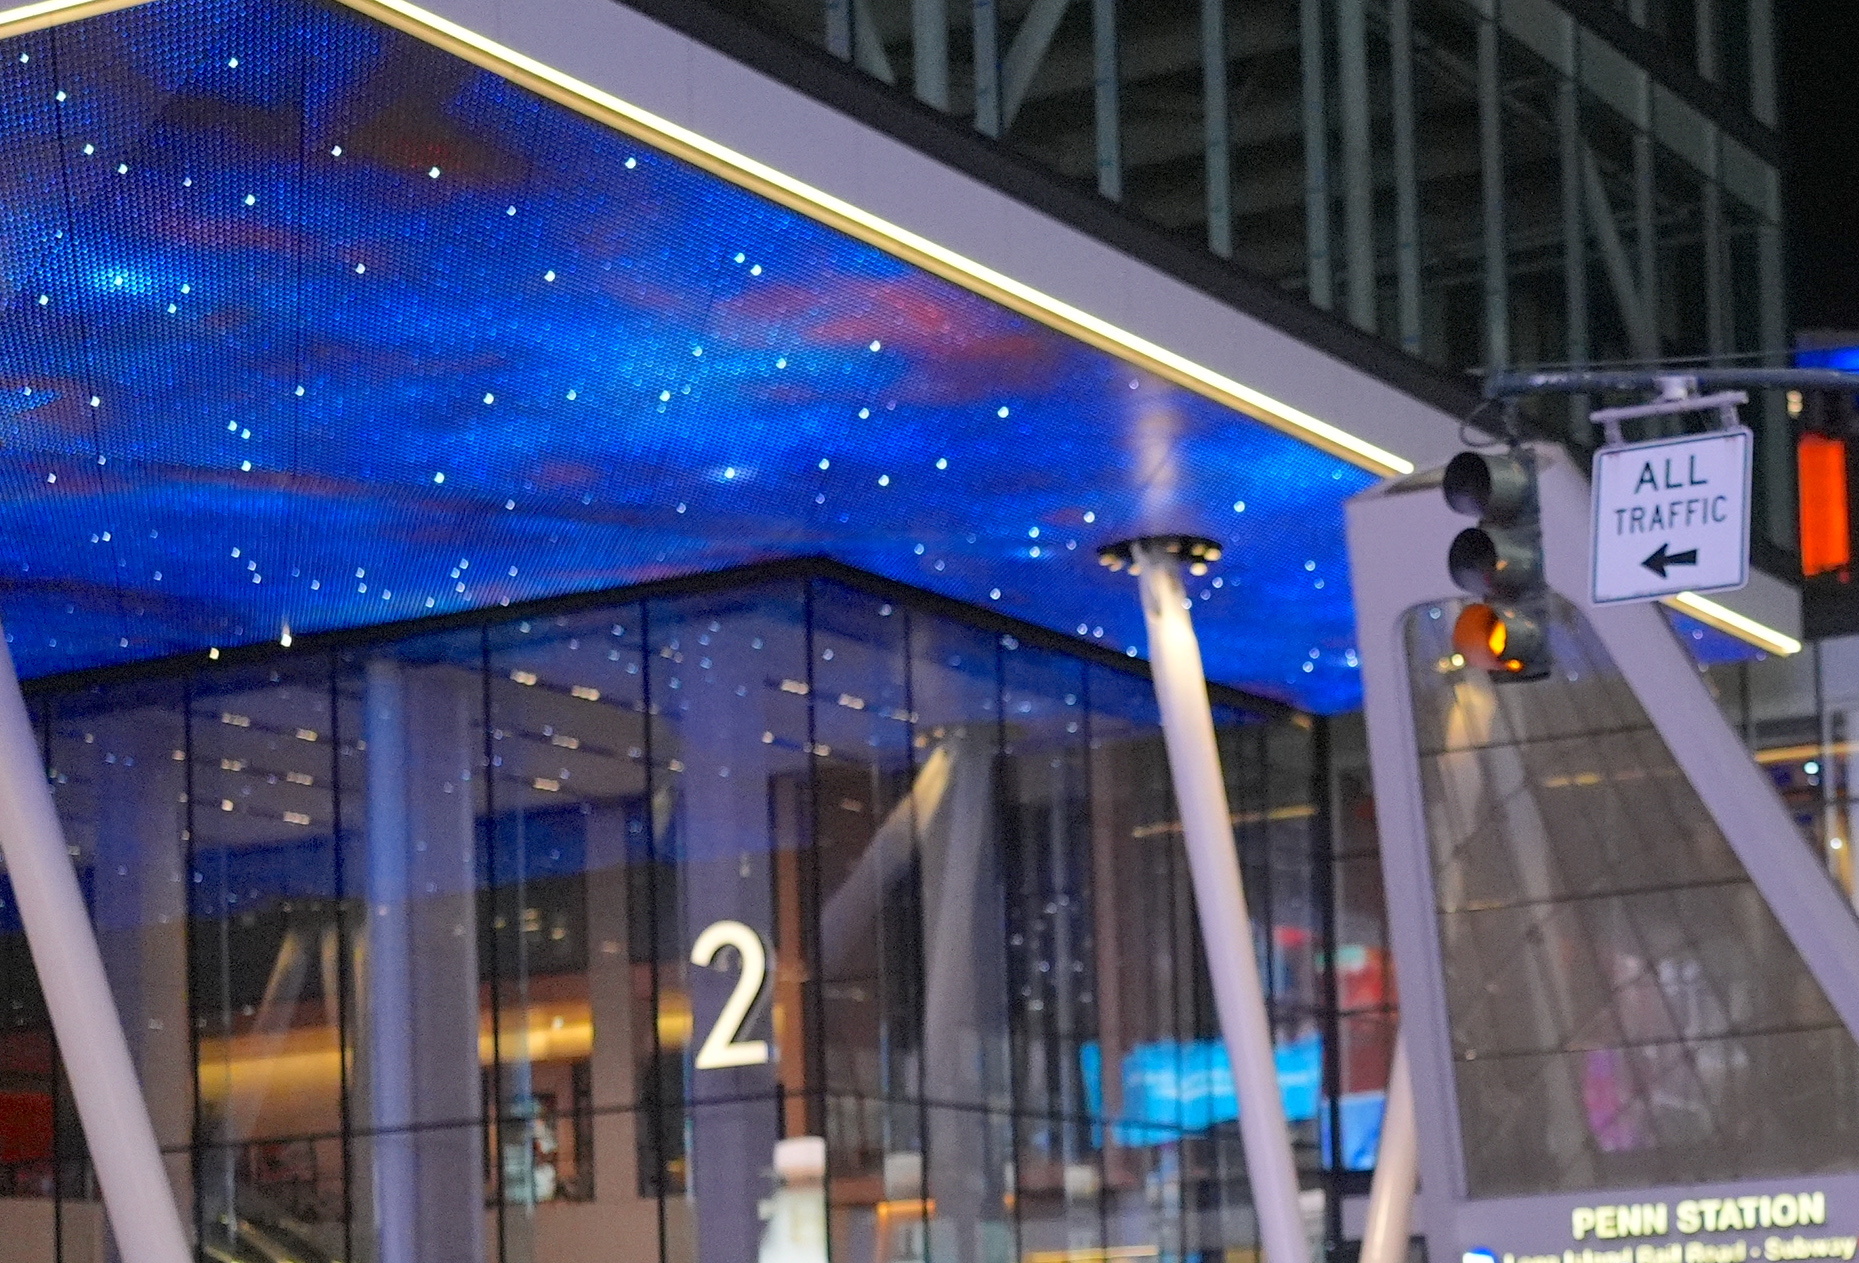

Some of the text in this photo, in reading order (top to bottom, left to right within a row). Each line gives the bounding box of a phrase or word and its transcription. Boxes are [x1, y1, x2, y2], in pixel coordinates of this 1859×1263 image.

[1634, 455, 1708, 494] ALL
[1615, 495, 1727, 535] TRAFFIC
[690, 919, 768, 1070] 2
[1571, 1191, 1825, 1240] PENN STATION
[1764, 1234, 1858, 1261] Subway
